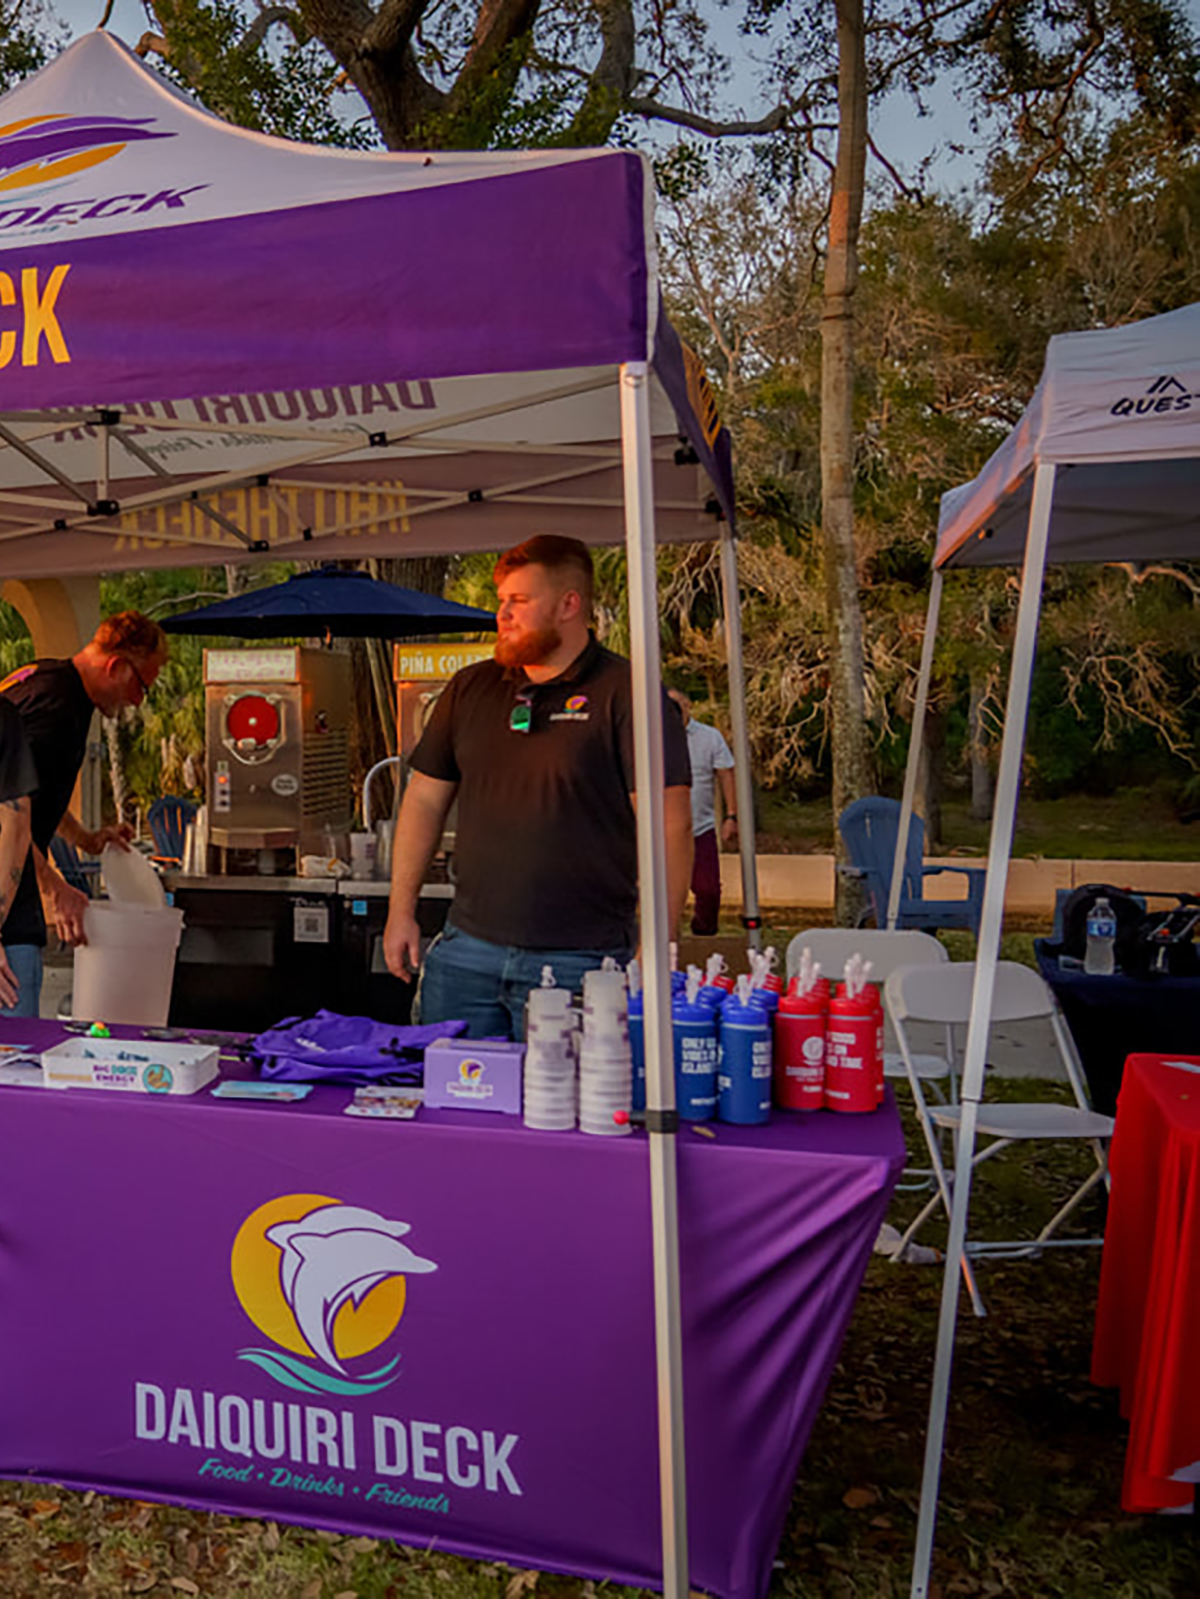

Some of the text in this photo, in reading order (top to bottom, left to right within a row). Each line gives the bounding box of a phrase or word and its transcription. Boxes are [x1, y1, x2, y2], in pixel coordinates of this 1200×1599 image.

[400, 651, 434, 674] PIÑA
[135, 1382, 523, 1496] DAIQUIRI DECK
[198, 1458, 450, 1514] Food Drinks Friends
